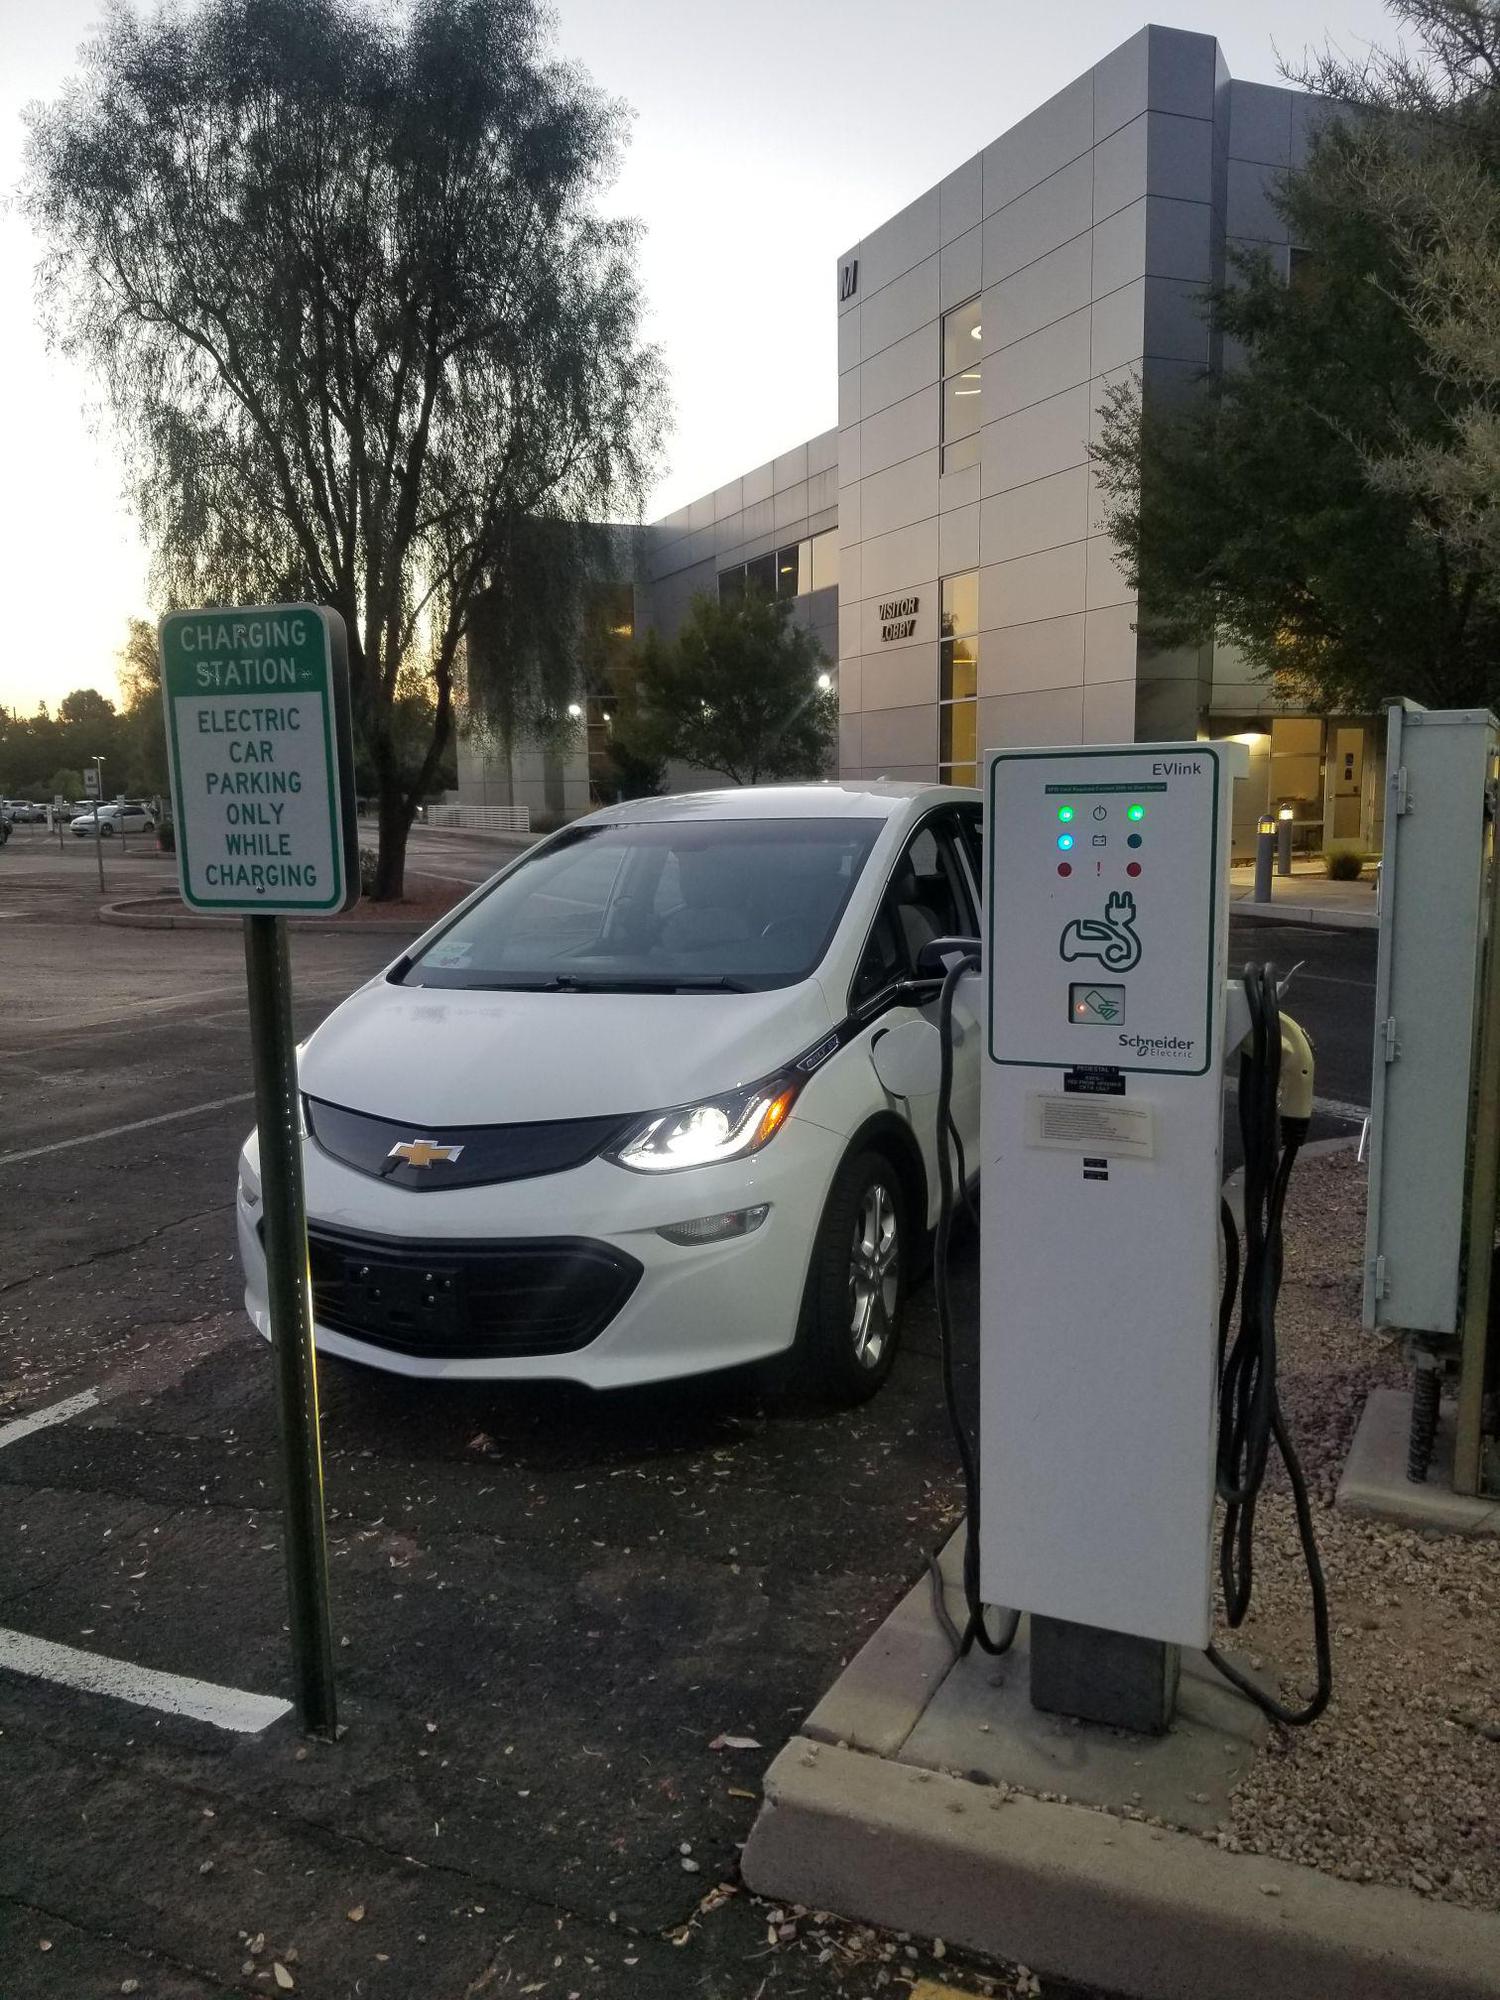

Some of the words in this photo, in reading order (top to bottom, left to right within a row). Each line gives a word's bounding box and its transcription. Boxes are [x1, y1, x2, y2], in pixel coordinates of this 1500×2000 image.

[879, 597, 920, 621] VISITOR
[180, 619, 307, 651] CHARGING
[881, 620, 916, 642] LOBBY
[196, 656, 297, 687] STATION
[197, 707, 301, 734] ELECTRIC
[229, 740, 274, 763] CAR
[1152, 762, 1202, 776] EVlink
[205, 771, 302, 795] PARKING
[226, 802, 285, 826] ONLY
[225, 833, 292, 857] WHILE
[205, 864, 317, 888] CHARGING
[1118, 1034, 1195, 1050] Schneider
[1150, 1049, 1193, 1059] Electric
